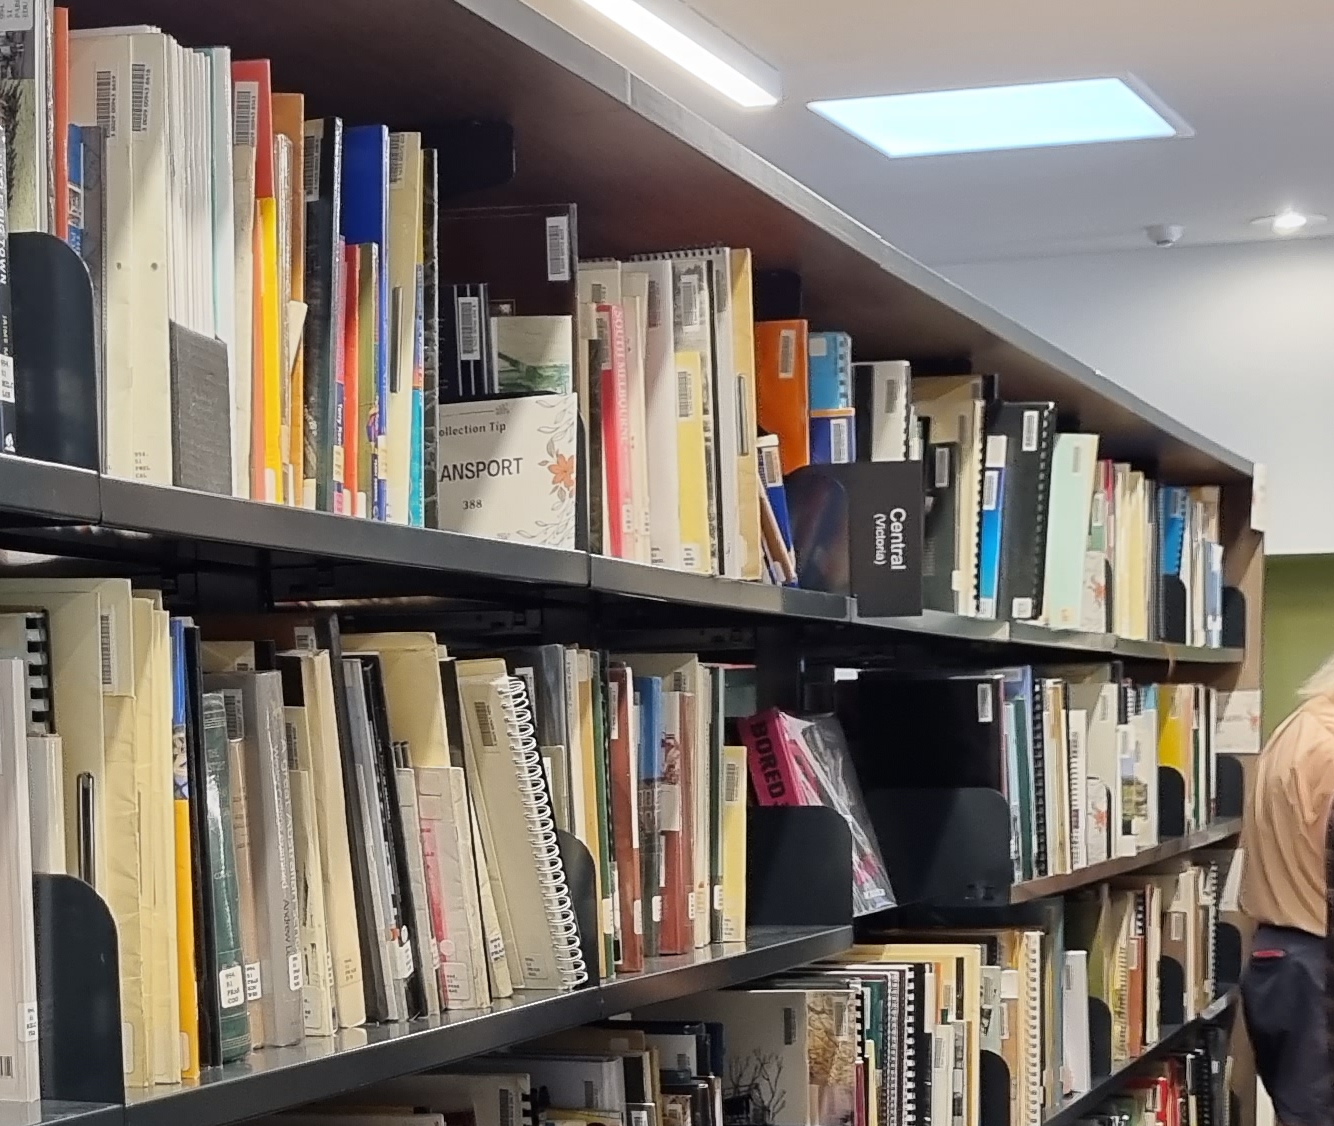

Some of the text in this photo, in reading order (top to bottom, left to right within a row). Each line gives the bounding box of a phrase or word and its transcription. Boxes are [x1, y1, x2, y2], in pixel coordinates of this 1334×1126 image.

[615, 311, 629, 445] SOUTH MELBOURNE
[439, 422, 506, 437] ollection Tip
[438, 458, 523, 482] ANSPORT
[462, 500, 483, 511] 388
[873, 513, 887, 565] (Victoria)
[889, 507, 907, 570] Central
[750, 723, 786, 799] BORED
[285, 812, 298, 903] Australian
[283, 898, 292, 943] Andrew
